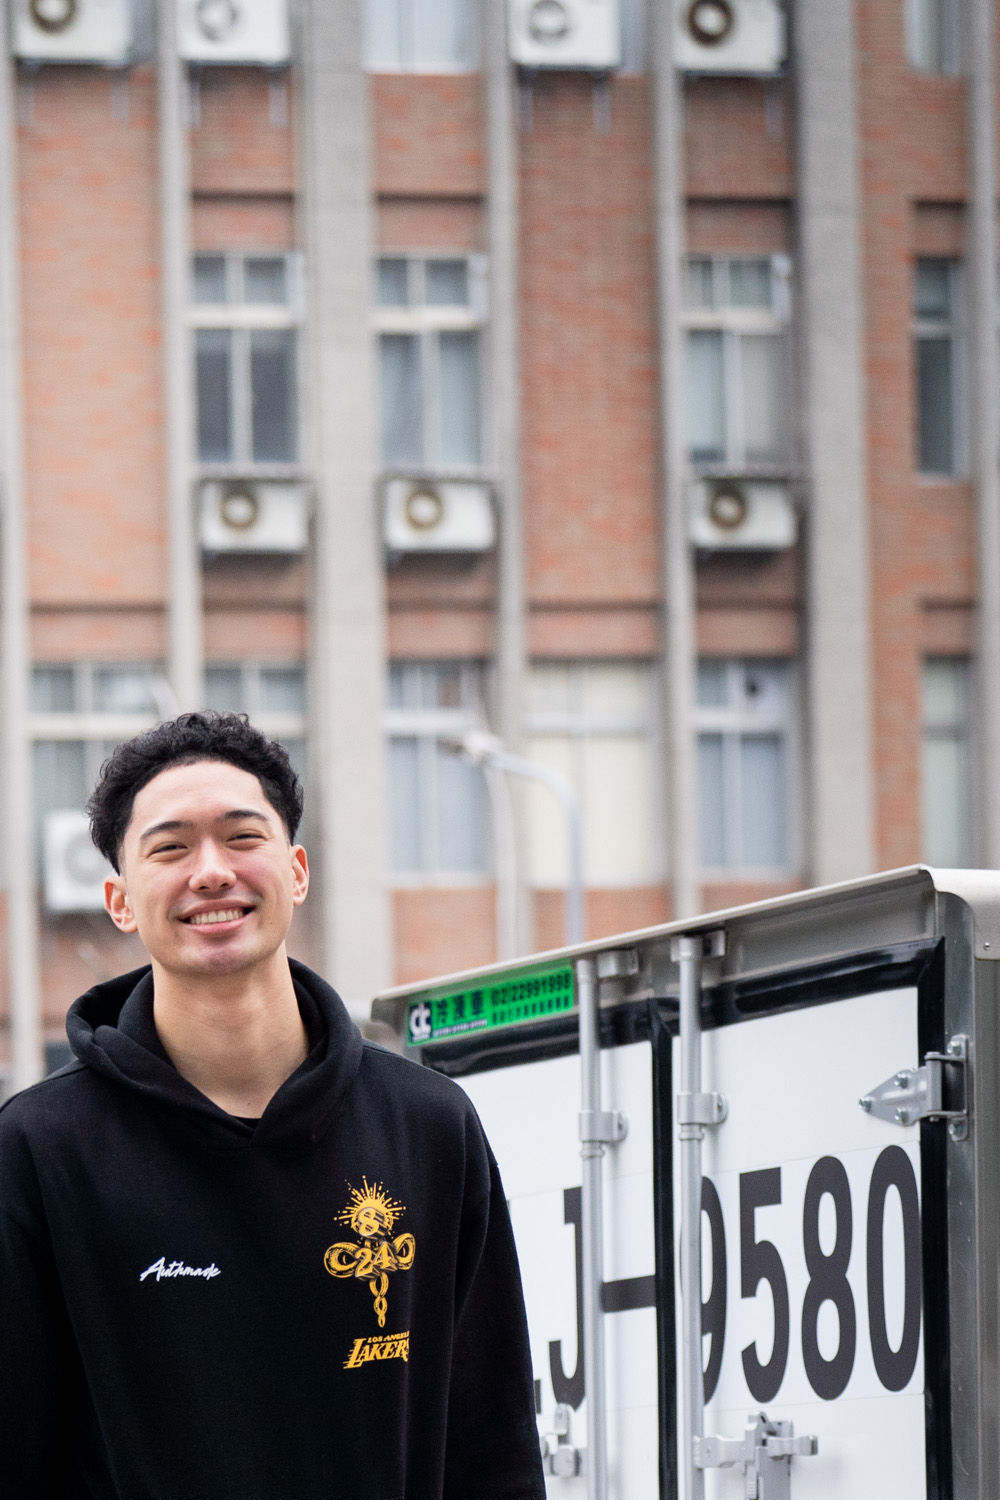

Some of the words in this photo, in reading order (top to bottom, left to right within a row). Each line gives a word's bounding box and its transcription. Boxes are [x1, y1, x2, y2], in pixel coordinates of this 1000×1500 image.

[139, 1256, 221, 1282] Authmade
[354, 1241, 395, 1278] 24
[367, 1336, 383, 1344] LOS
